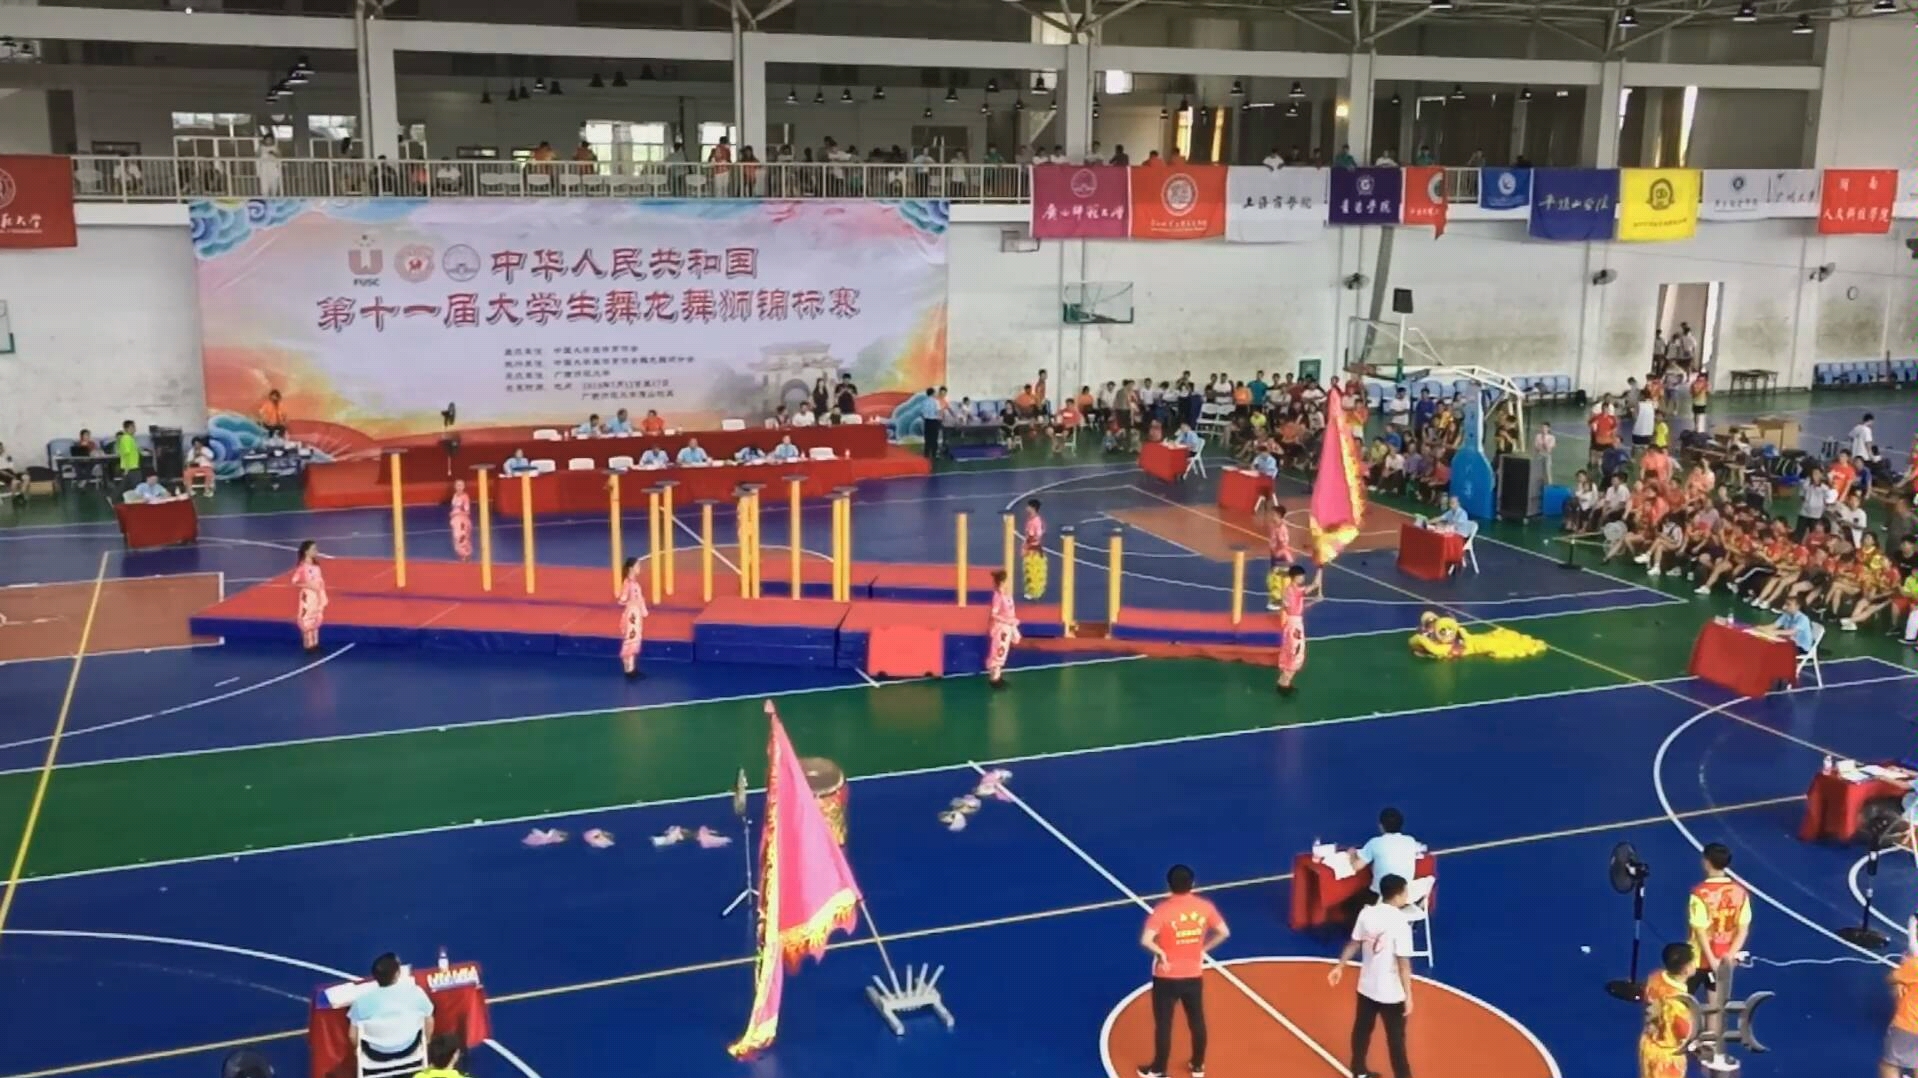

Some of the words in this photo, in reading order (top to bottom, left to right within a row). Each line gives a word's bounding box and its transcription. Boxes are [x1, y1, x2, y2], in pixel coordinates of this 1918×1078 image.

[353, 278, 381, 287] FUSC
[491, 247, 759, 284] 中华人民共和国
[316, 287, 861, 333] 第十一届大学生舞龙舞狮锦标赛
